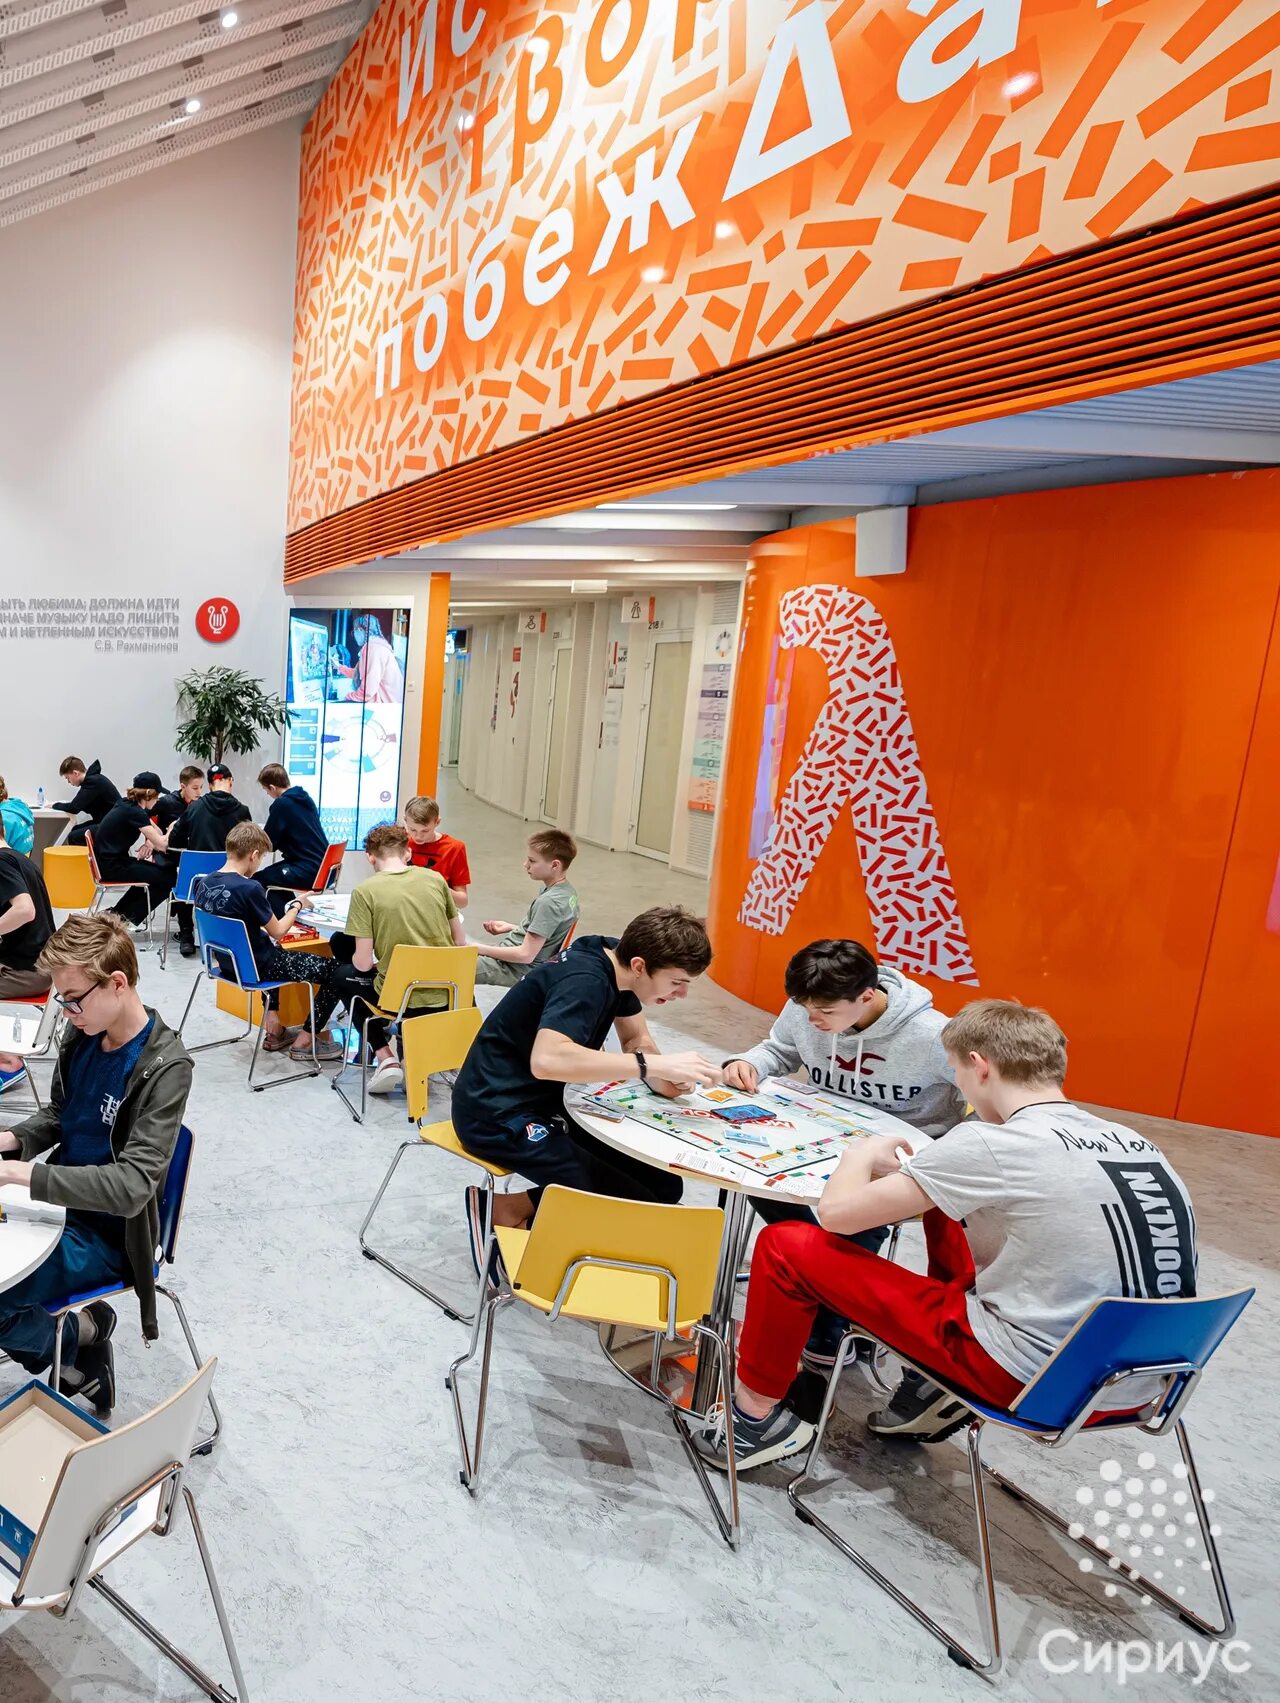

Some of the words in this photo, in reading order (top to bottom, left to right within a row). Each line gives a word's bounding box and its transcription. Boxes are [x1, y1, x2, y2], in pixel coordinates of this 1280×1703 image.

[89, 598, 145, 611] ДОЛЖНА
[147, 598, 180, 611] ИДТИ
[37, 613, 87, 625] МУЗЫКУ
[90, 613, 124, 625] НАДО
[127, 613, 180, 625] ЛИШИТЬ
[10, 627, 18, 639] И
[20, 627, 95, 639] НЕТЛЕННЫМ
[98, 627, 179, 639] ИСКУССТВОМ
[117, 640, 179, 652] Рахманинов
[805, 1064, 922, 1101] OLLISTER
[1051, 1128, 1108, 1153] New
[1119, 1170, 1183, 1299] OOKLYN
